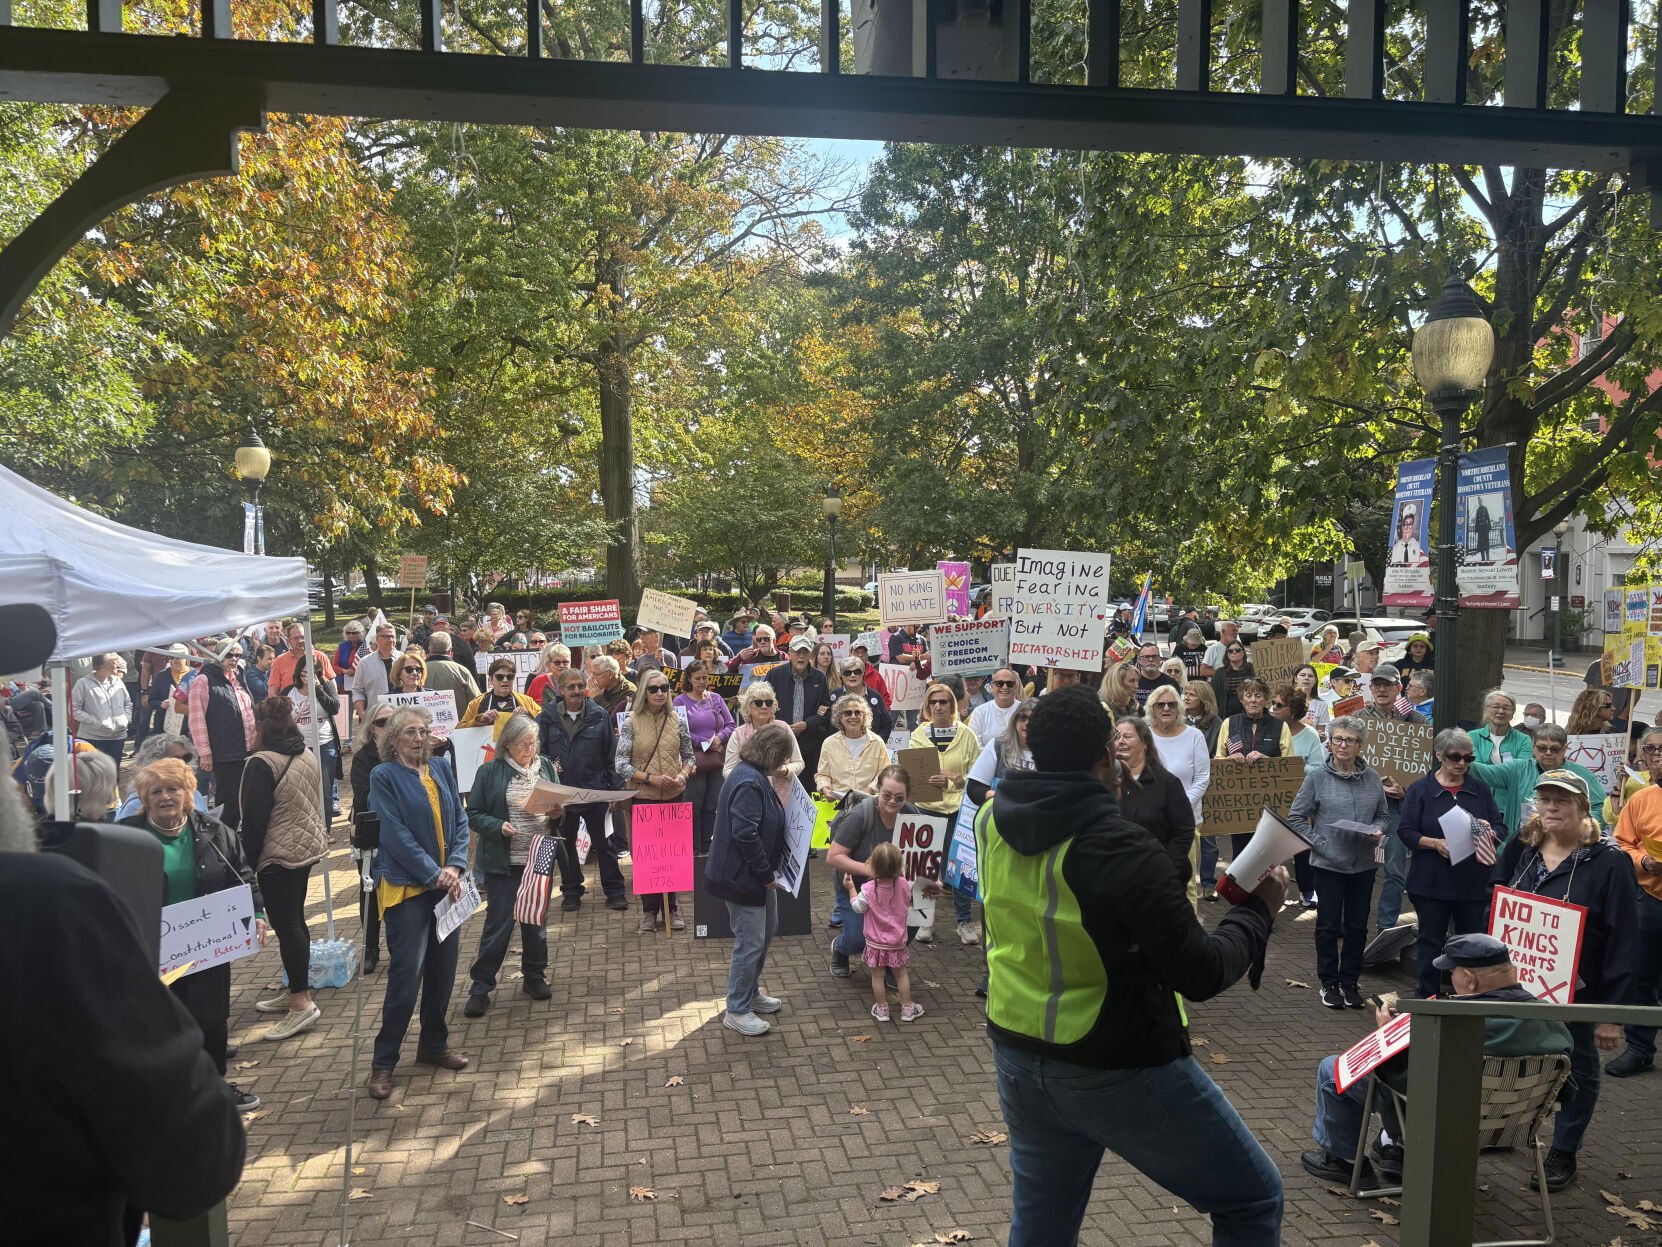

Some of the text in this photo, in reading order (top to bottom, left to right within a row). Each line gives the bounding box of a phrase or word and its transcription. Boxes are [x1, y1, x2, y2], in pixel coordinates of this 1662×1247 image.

[1473, 474, 1493, 483] COUNTY
[1484, 480, 1511, 489] VETERANS
[993, 567, 1012, 582] DUE
[890, 585, 904, 596] NO
[570, 606, 588, 614] FAIR
[590, 604, 617, 613] SHARE
[891, 597, 936, 613] NO HATE
[1015, 601, 1098, 618] DIVERSITY
[578, 612, 618, 620] AMERICANS
[564, 623, 620, 633] NOT BAILOUTS
[579, 631, 620, 639] BILLIONAIRES
[934, 620, 1005, 635] WE SUPPORT
[1014, 620, 1043, 635] But
[947, 638, 980, 648] CHOICE
[1011, 642, 1100, 660] DICTATORSHIP
[948, 647, 988, 657] FREEDOM
[486, 652, 542, 673] PTECT
[948, 655, 999, 666] DEMOCRACY
[706, 675, 723, 687] OR
[724, 675, 743, 686] THE
[1257, 665, 1299, 681] ESISTAN
[885, 668, 908, 702] NO
[436, 710, 454, 721] USA
[1358, 718, 1434, 739] EMOCRAC
[1377, 732, 1421, 748] DIES
[1362, 755, 1389, 768] NOT
[1383, 746, 1432, 762] SILEN
[1210, 758, 1289, 777] NGS FEAR
[1207, 775, 1280, 792] PROTEST
[799, 792, 816, 824] KINGS
[1202, 791, 1294, 809] AMERICANS
[636, 803, 692, 823] NO KINGS
[655, 828, 664, 838] IN
[899, 822, 934, 849] NO
[636, 842, 688, 862] AMERICA
[651, 864, 673, 874] SINCE
[901, 850, 943, 882] INGS
[960, 863, 978, 882] PEAC
[649, 875, 673, 889] 1776
[160, 904, 237, 938] Dissent is
[1498, 897, 1560, 929] NO TO
[160, 916, 252, 966] onstitutional!
[1508, 948, 1557, 972] YRANTS
